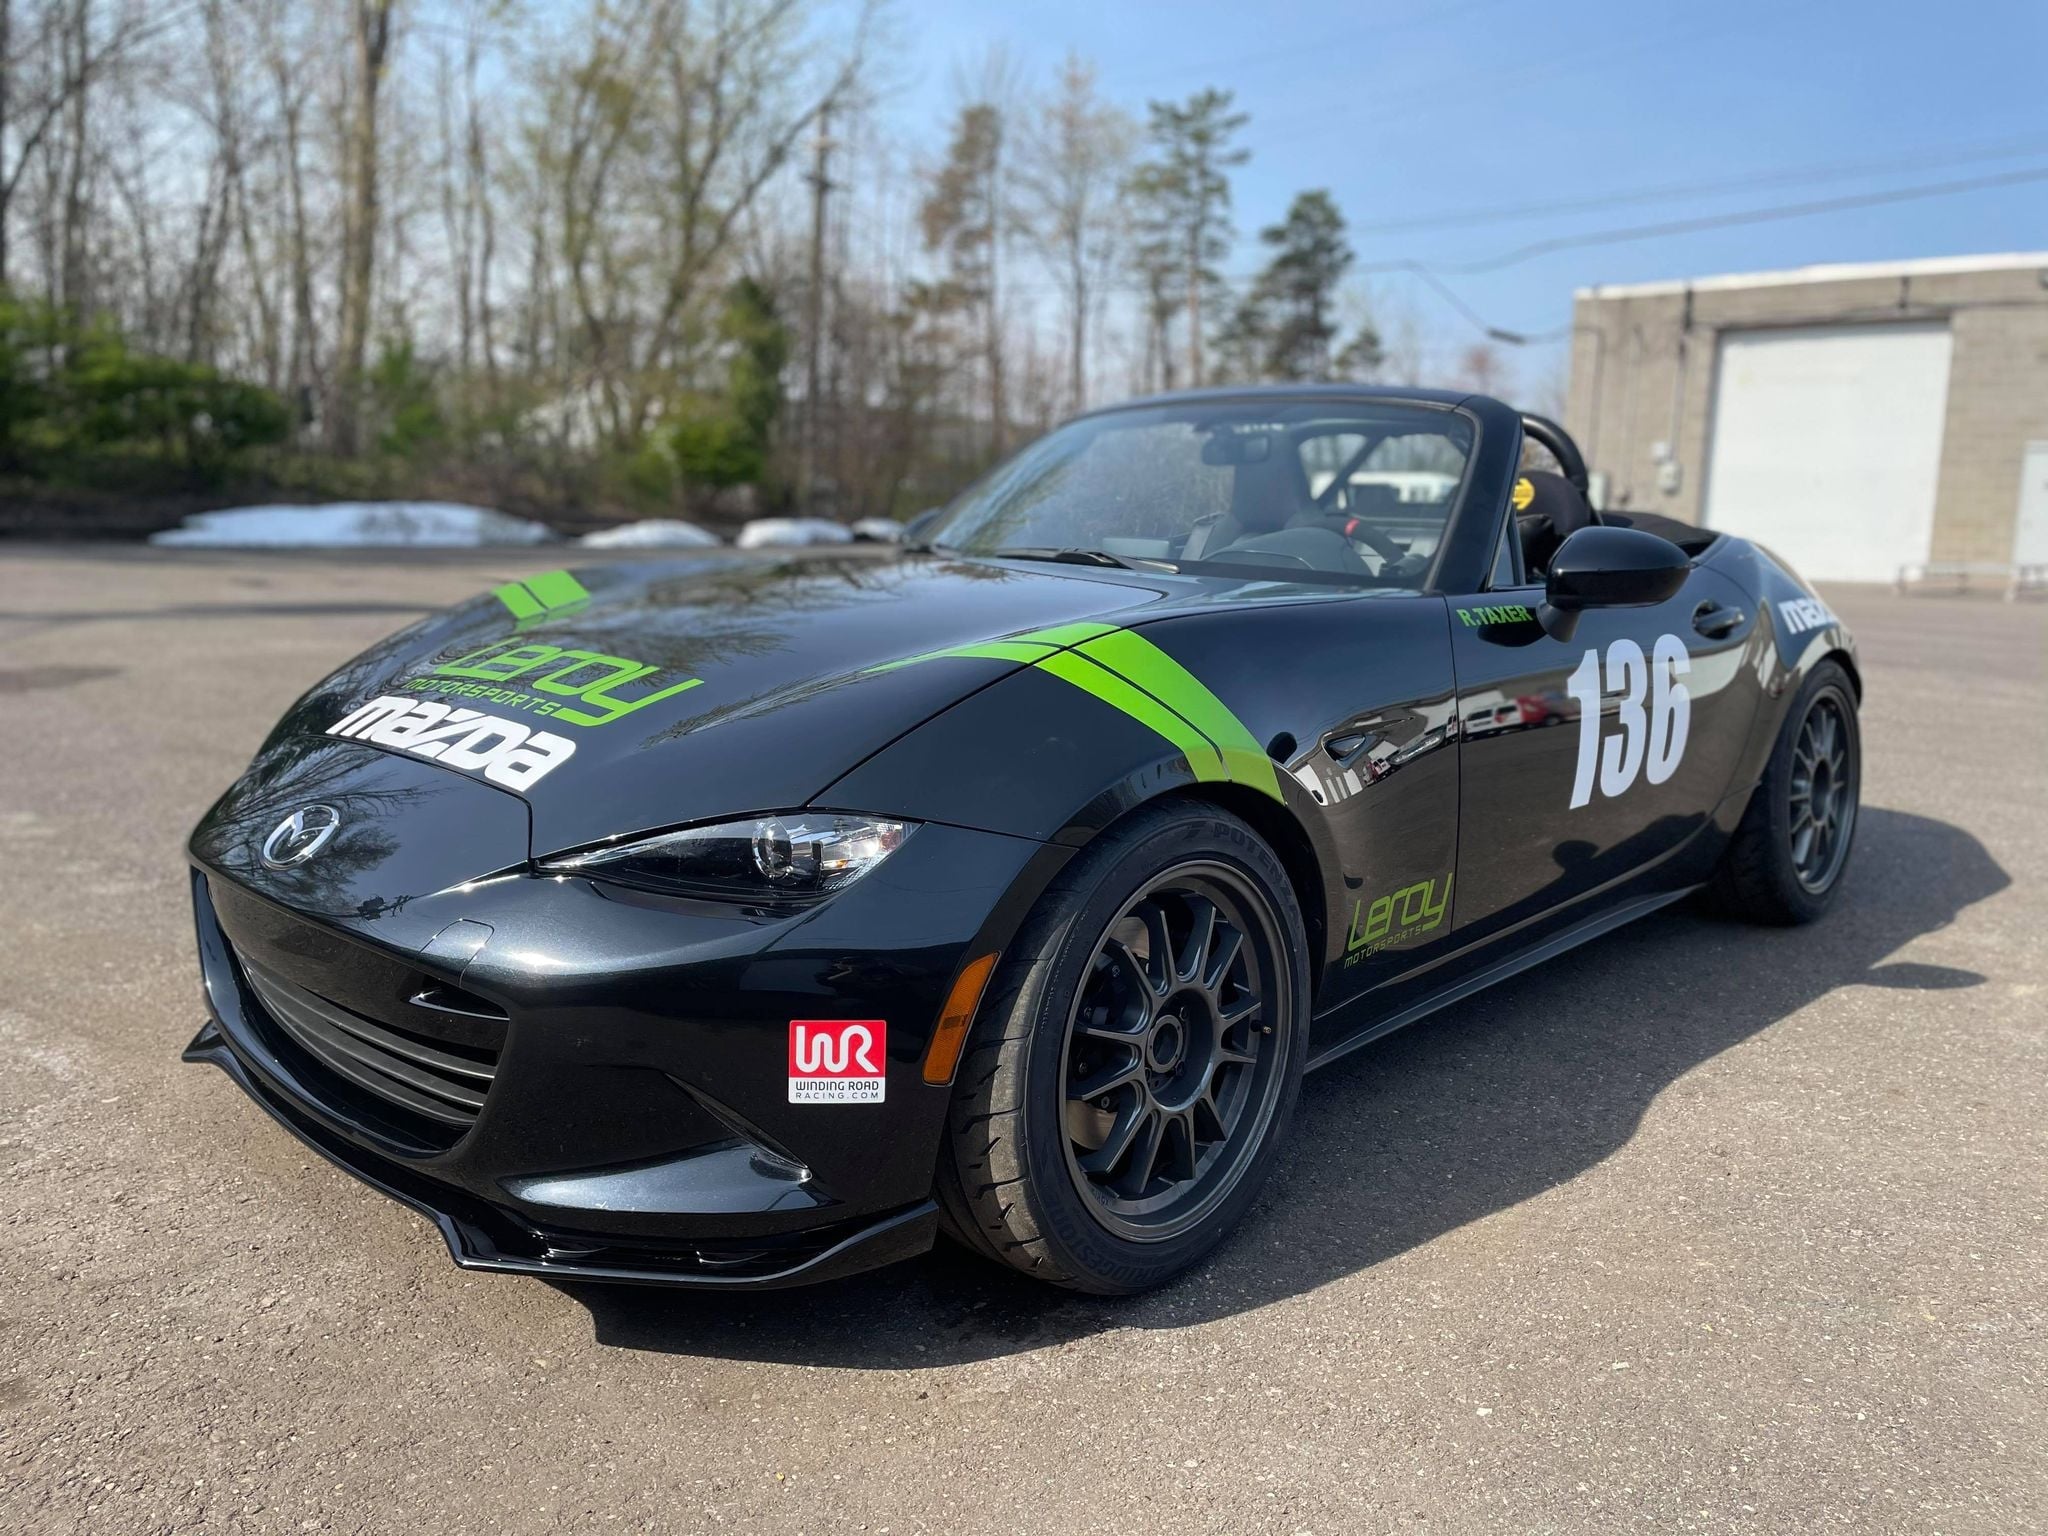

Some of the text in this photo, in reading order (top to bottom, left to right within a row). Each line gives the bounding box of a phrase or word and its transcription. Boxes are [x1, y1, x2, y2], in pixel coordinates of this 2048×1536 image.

[1456, 605, 1533, 627] R.TAXER
[404, 677, 564, 717] MOTORSPORTS
[433, 637, 704, 727] Leroy
[1567, 634, 1691, 810] 136
[1213, 822, 1300, 921] POTENZA
[1348, 872, 1453, 951] Leroy
[1343, 925, 1422, 970] MOTORSPORTS
[796, 1024, 880, 1073] WR
[795, 1081, 879, 1091] WINDING ROAD
[795, 1092, 879, 1100] RACING.COM
